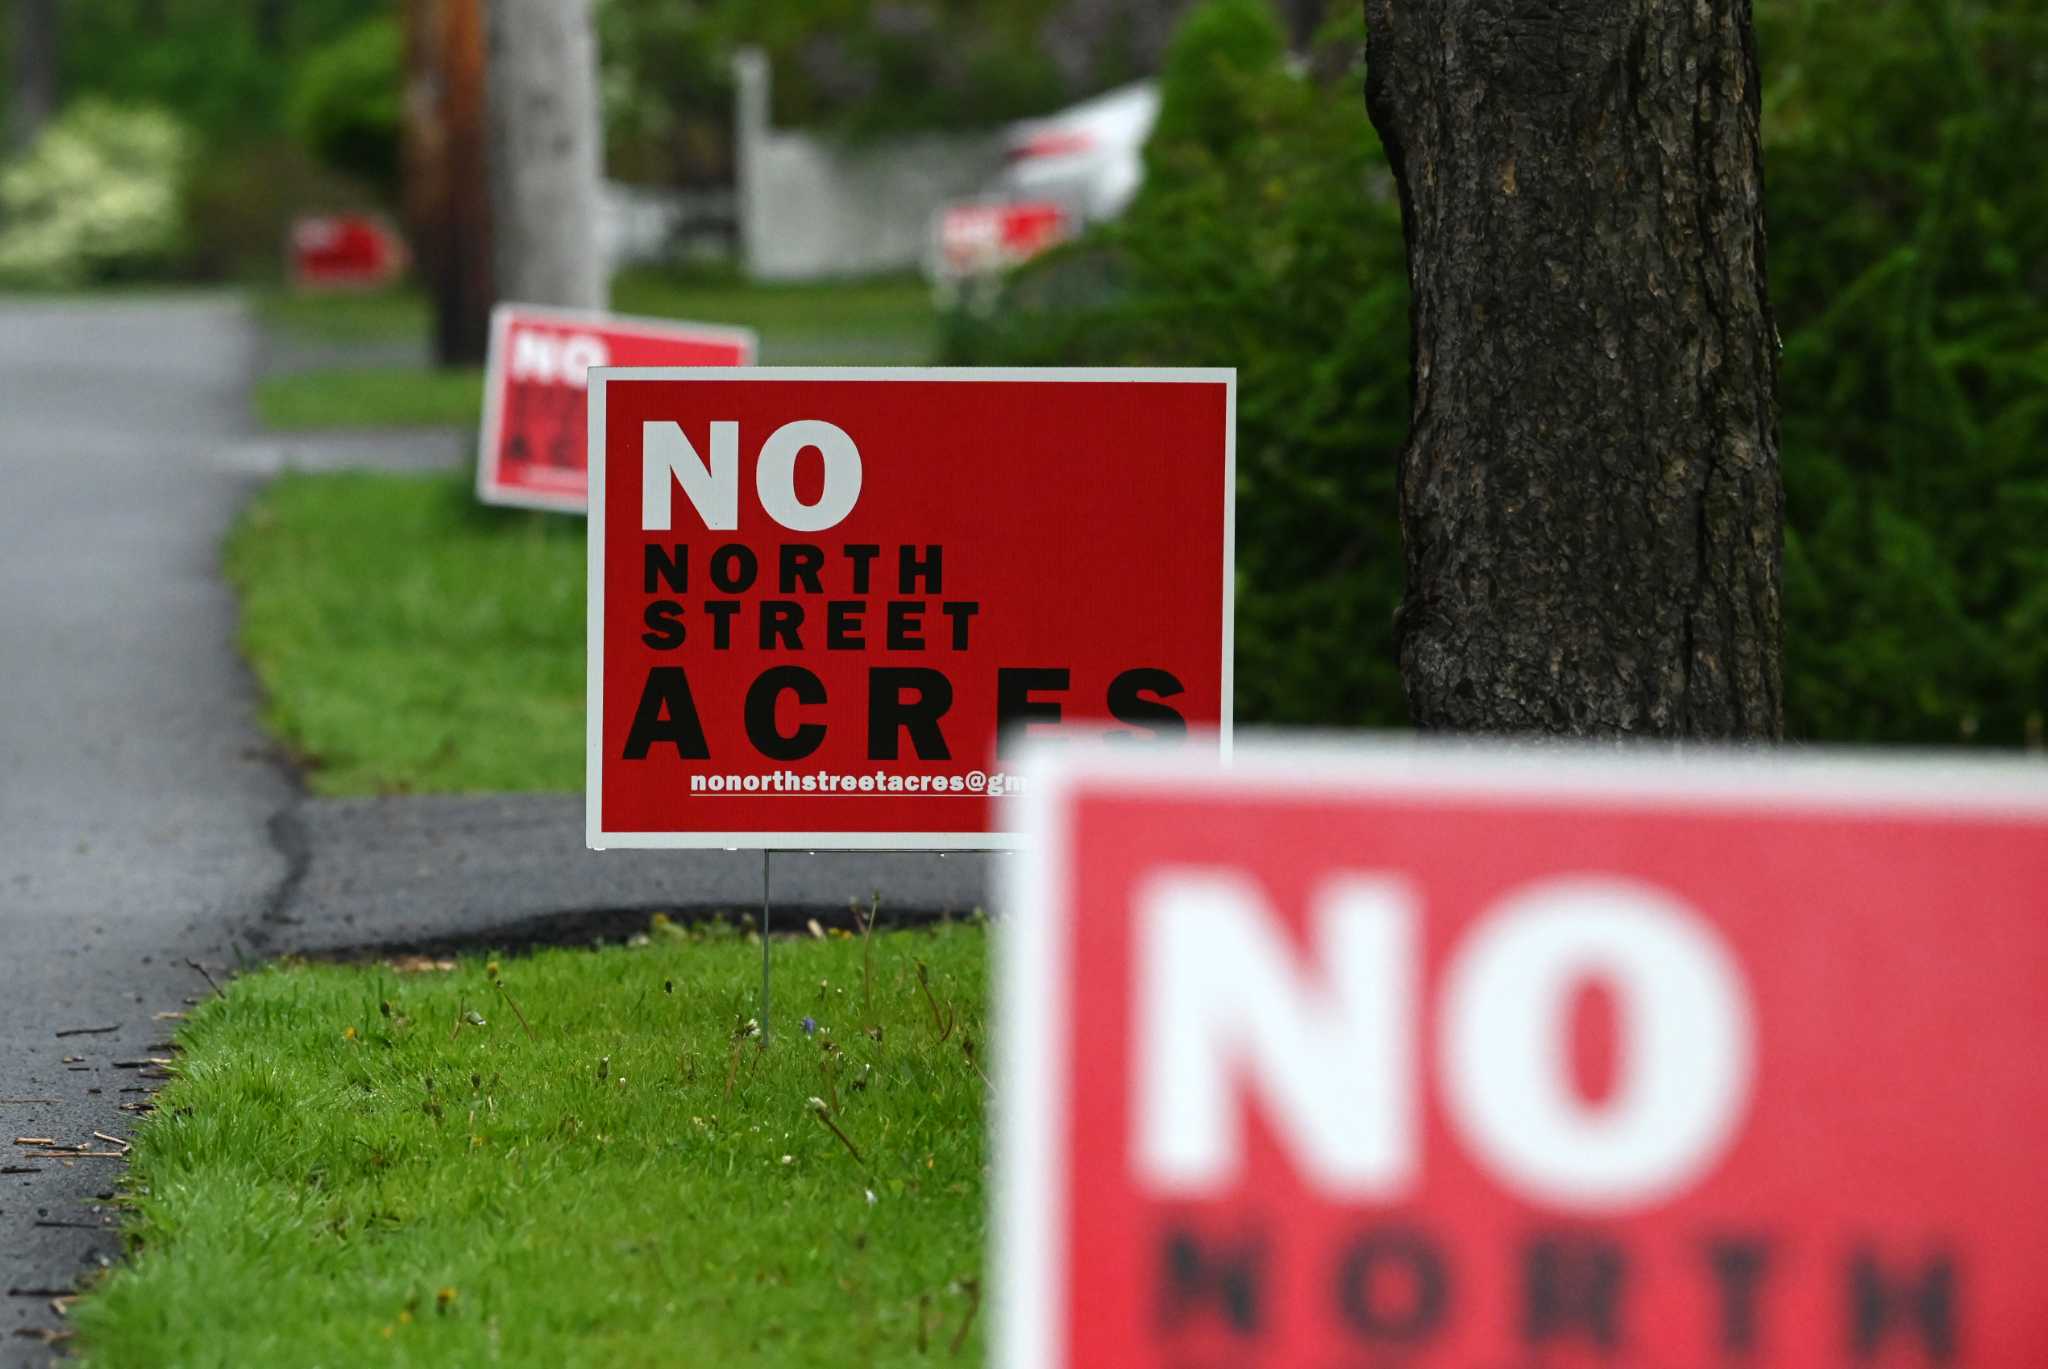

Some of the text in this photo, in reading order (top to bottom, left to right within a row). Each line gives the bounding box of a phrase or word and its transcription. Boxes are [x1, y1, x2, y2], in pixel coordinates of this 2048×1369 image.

[512, 328, 608, 388] NO
[642, 420, 863, 532] NO
[643, 544, 943, 595] NORTH
[641, 600, 979, 651] STREET
[621, 665, 1188, 761] ACRES
[690, 769, 1029, 795] nonorthstreetacres@gm
[1130, 866, 1757, 1212] NO
[1150, 1220, 1965, 1364] NORTH
